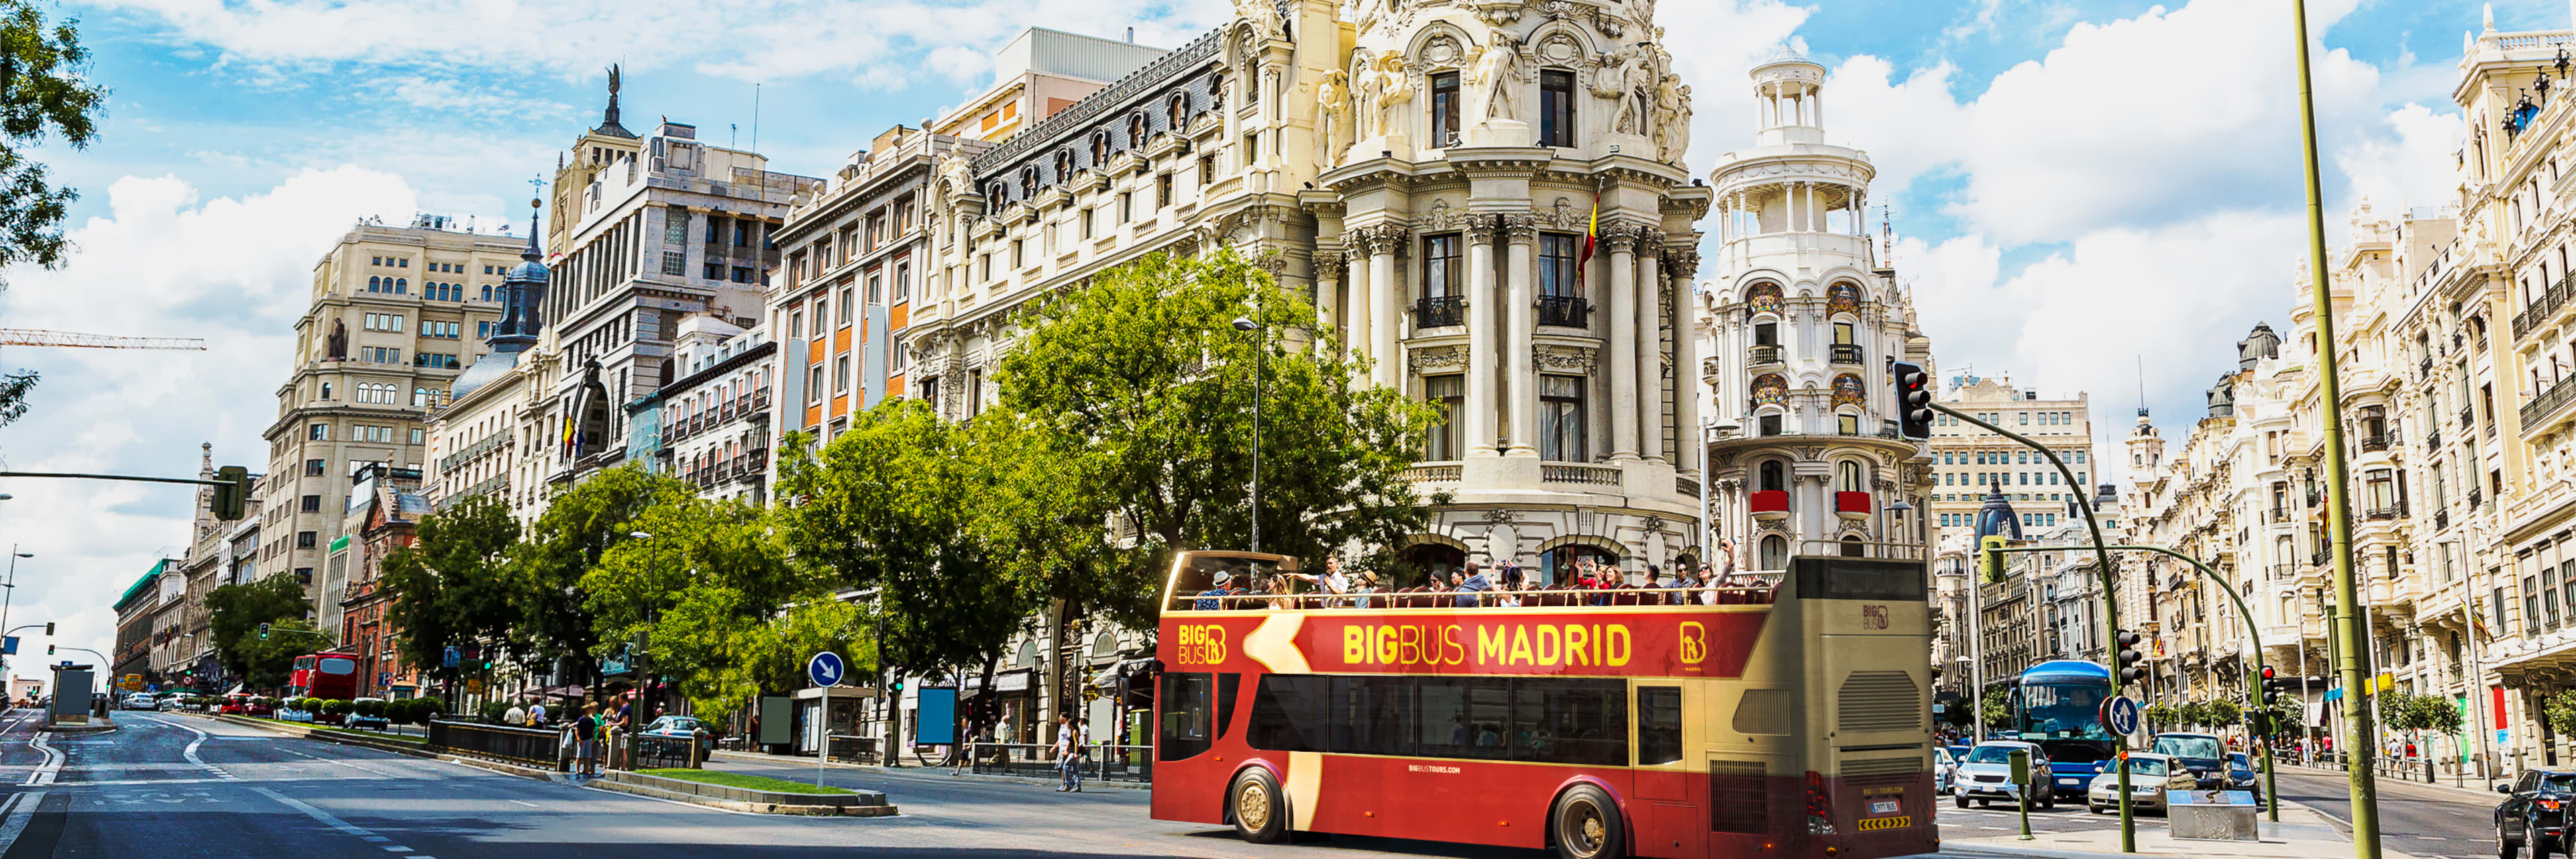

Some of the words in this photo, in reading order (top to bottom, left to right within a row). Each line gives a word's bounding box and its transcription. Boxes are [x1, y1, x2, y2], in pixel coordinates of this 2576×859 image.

[1863, 605, 1878, 617] BIG
[1864, 617, 1878, 629] BUS
[1179, 625, 1205, 645] BIG
[1477, 623, 1631, 666] MADRID
[1179, 646, 1205, 664] BUS
[1409, 764, 1460, 774] BIGBUSTOURS.COM
